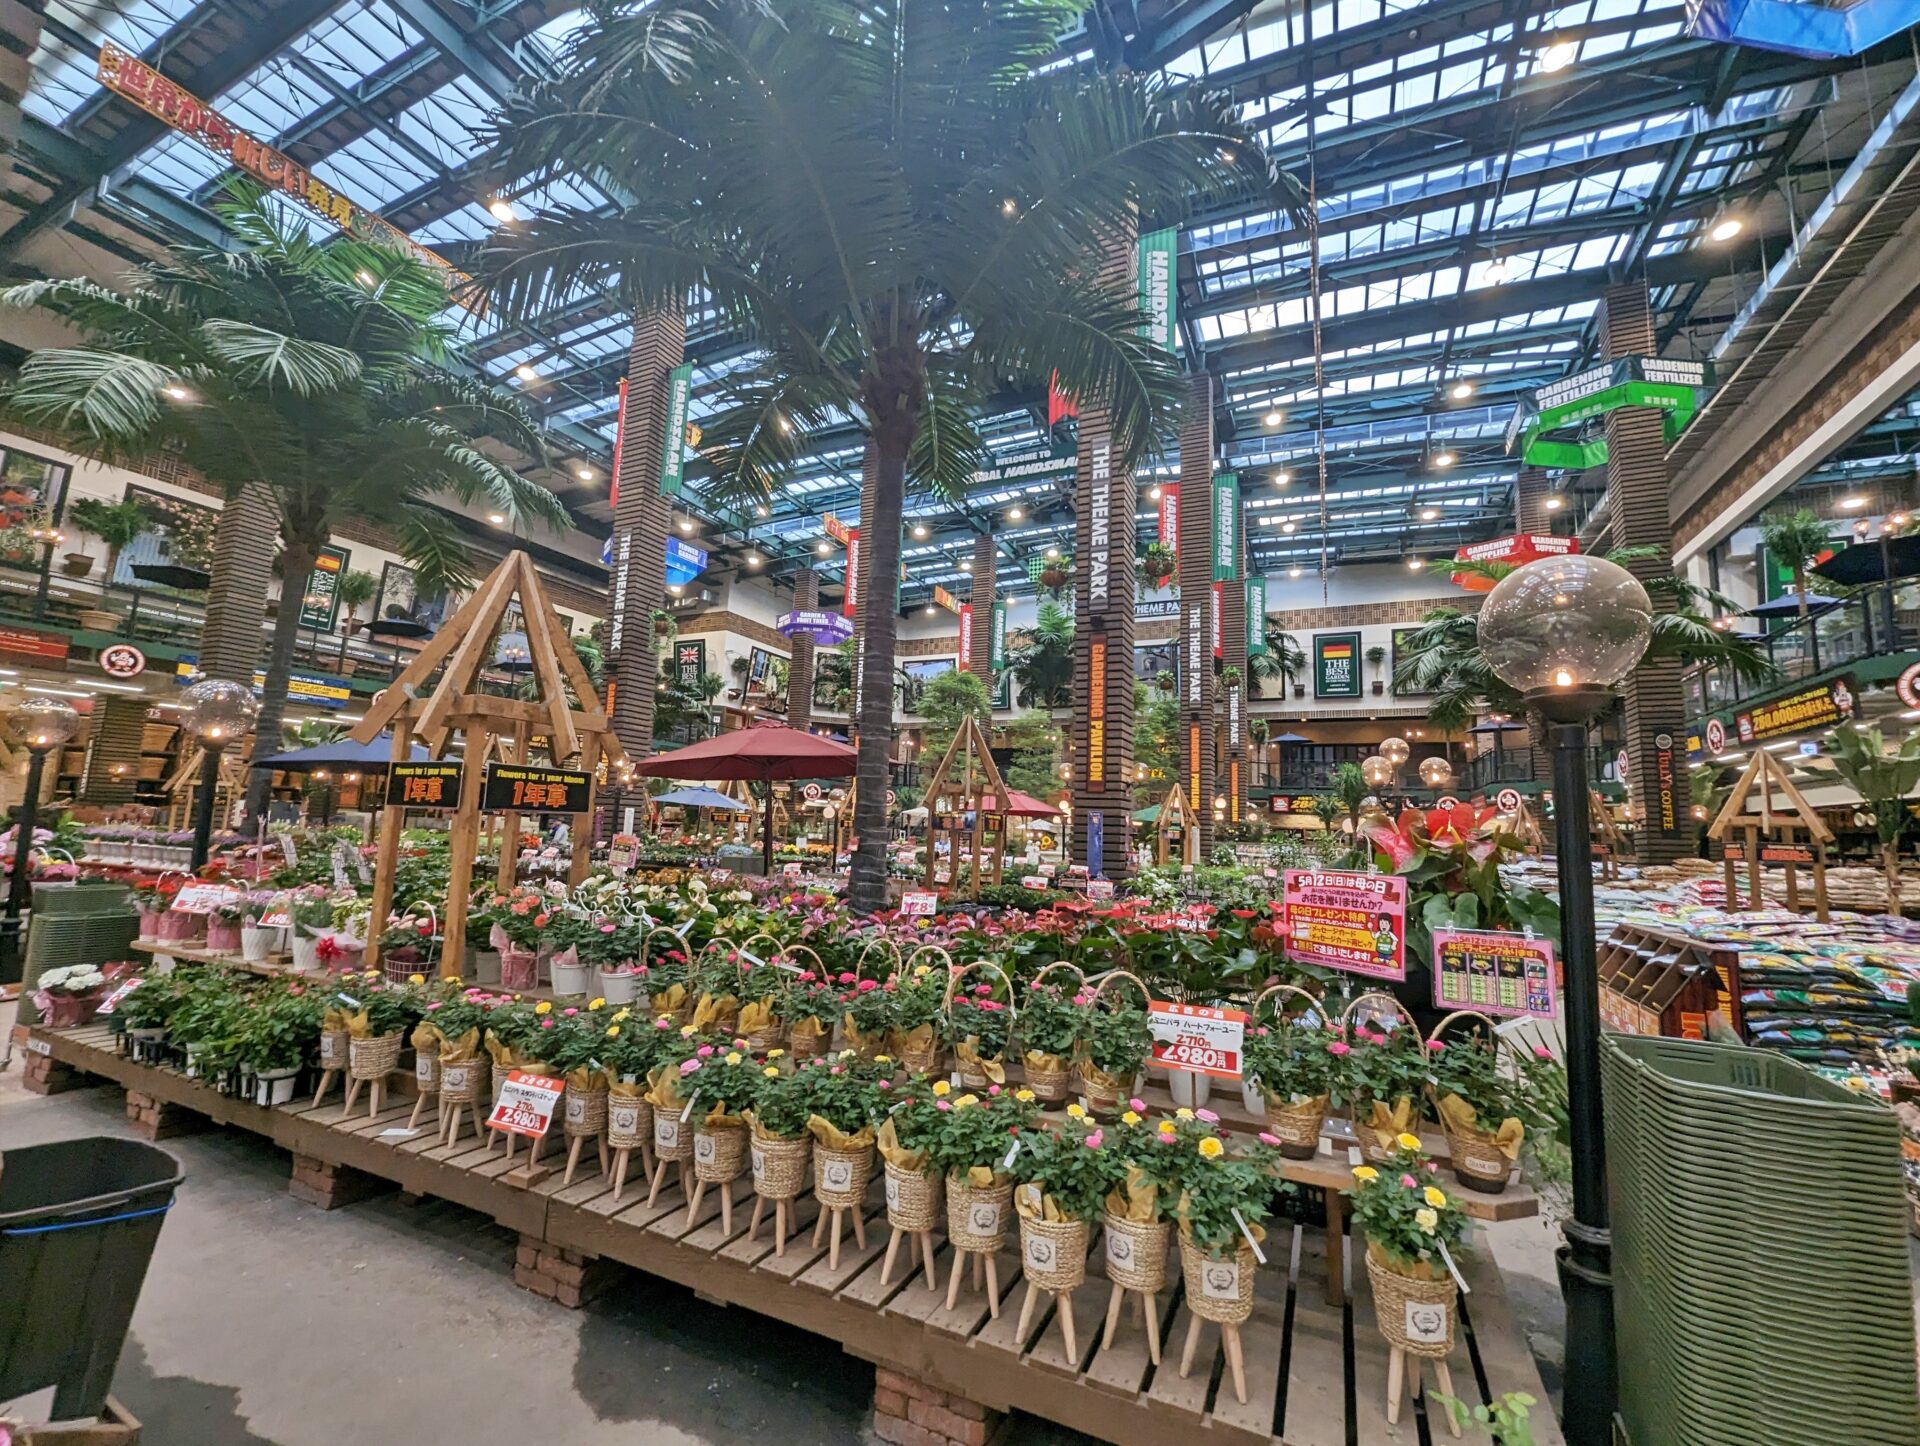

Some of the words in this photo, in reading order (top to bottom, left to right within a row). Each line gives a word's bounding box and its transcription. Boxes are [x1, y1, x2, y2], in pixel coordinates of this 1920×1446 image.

[1151, 251, 1168, 351] HANDSM
[1641, 358, 1704, 374] GARDENING
[1645, 370, 1703, 385] FERTILIZER
[1535, 364, 1613, 400] GARDENING
[1539, 377, 1611, 411] FERTILIZER
[668, 379, 687, 477] HANDSMAN
[995, 452, 1037, 466] WELCOME
[1039, 450, 1051, 458] TO
[1092, 445, 1110, 479] THE
[1091, 484, 1109, 546] THEME
[1166, 495, 1177, 551] HANDS
[1221, 486, 1233, 567] HANDSMAN
[619, 534, 631, 561] THE
[678, 542, 699, 556] FLOWER
[1466, 538, 1515, 556] GARDENING
[1471, 547, 1511, 561] SUPPLIES
[1530, 536, 1571, 546] GARDENING
[1535, 543, 1568, 554] SUPPLIES
[678, 550, 699, 564] GARDEN
[614, 564, 629, 611] THEME
[1090, 551, 1108, 600] PARK
[1167, 601, 1181, 612] PA
[1190, 607, 1201, 629] THE
[1253, 586, 1262, 646] HANDSMAN
[610, 614, 624, 651] PARK
[1189, 632, 1201, 669] THEME
[1324, 659, 1350, 668] THE
[681, 665, 698, 674] THE
[682, 672, 698, 680] BEST
[1091, 644, 1104, 718] GARDENING
[1325, 667, 1350, 676] BEST
[1189, 672, 1201, 701] PARK
[606, 683, 616, 718] GARDE
[1230, 692, 1239, 721] THEME
[1230, 722, 1239, 745] PARK
[1090, 720, 1103, 782] PAVILION
[403, 777, 444, 803] 1年草
[497, 769, 526, 780] Flowers
[528, 772, 540, 780] for
[546, 774, 564, 782] year
[564, 775, 585, 785] bloom
[513, 781, 568, 808] 1年草
[1191, 773, 1200, 810] PAVILION
[1661, 790, 1674, 830] COFFEE
[1298, 875, 1386, 894] 5月12日(日)は母の日
[1290, 905, 1367, 923] 母の日プレゼント特典
[1301, 894, 1383, 911] お花を贈りませんか?
[1312, 926, 1357, 937] メッセージカード
[1153, 1016, 1180, 1027] ミニバラ
[1183, 1020, 1236, 1034] ハートフォーユー
